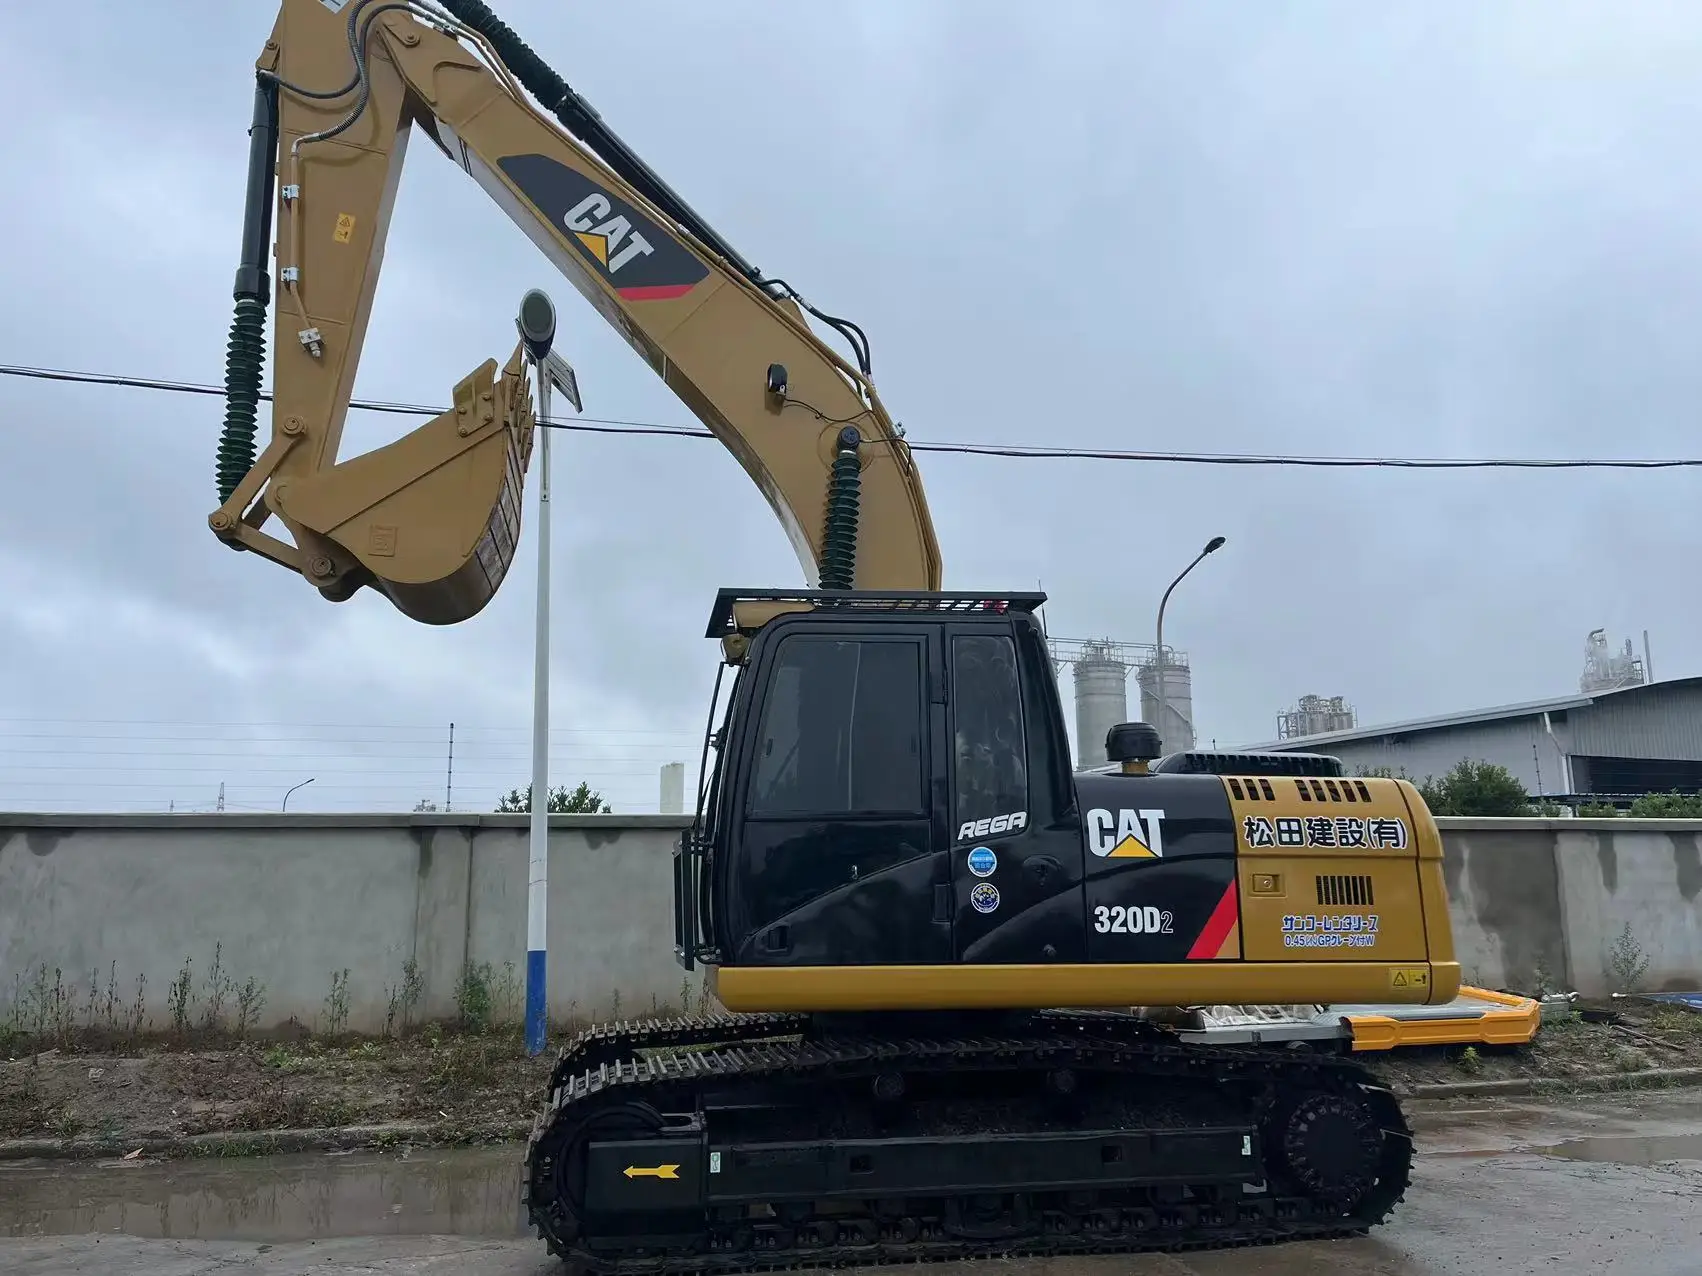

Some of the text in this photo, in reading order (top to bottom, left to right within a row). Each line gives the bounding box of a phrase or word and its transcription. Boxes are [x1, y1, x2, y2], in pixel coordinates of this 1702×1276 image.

[564, 193, 655, 274] CAT
[957, 811, 1027, 840] REGA
[1087, 808, 1166, 858] CAT
[1243, 815, 1408, 848] 松田建設(有)
[1094, 905, 1174, 933] 320D2
[1281, 915, 1378, 931] サンコーレンタリース
